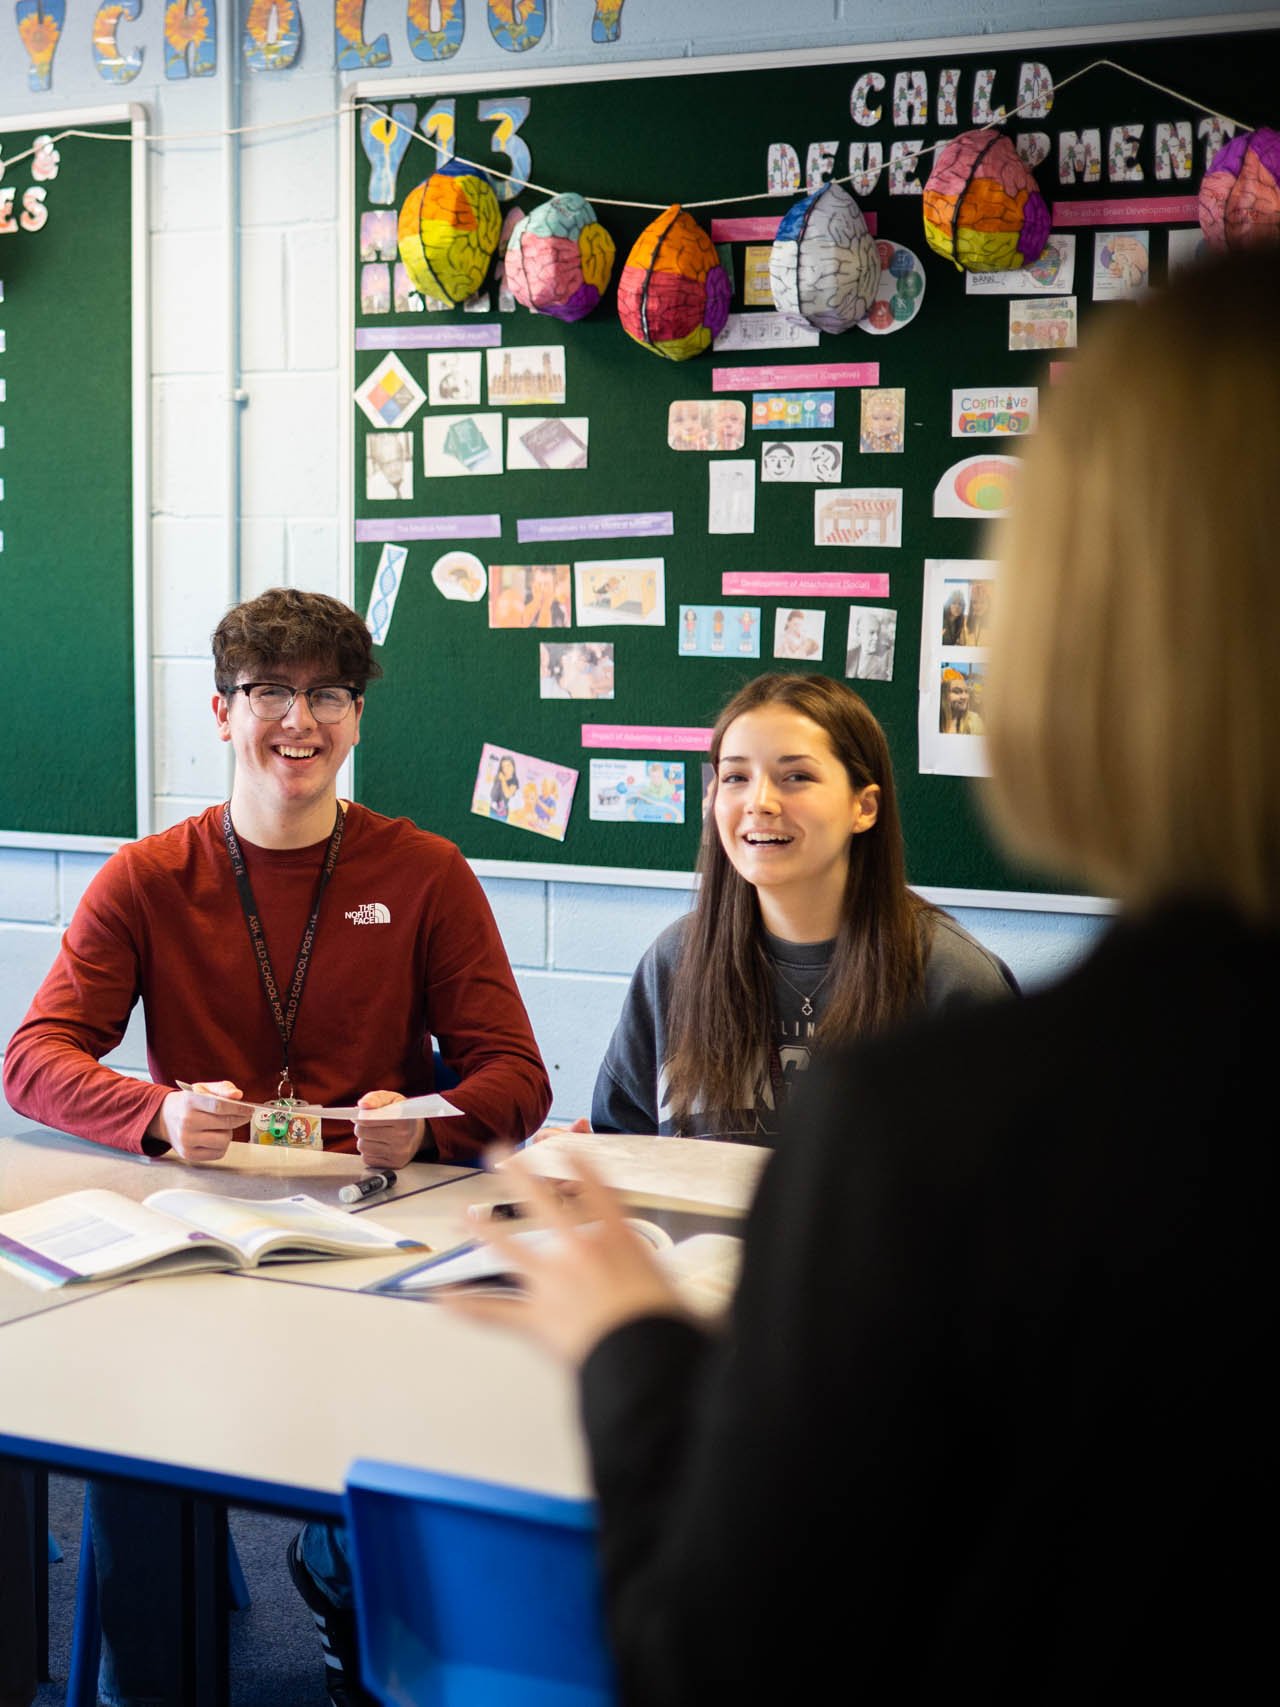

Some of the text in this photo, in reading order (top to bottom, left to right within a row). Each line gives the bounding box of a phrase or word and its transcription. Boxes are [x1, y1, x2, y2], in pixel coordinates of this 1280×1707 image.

[850, 61, 1054, 126] CHILD
[31, 135, 60, 181] &
[359, 97, 532, 204] Y13
[767, 116, 1237, 196] DEVEPMENT
[740, 578, 788, 590] Development
[228, 836, 242, 863] POST
[345, 911, 375, 919] NORTH
[353, 917, 375, 925] FACE
[358, 904, 375, 912] THE
[299, 928, 315, 957] POST
[260, 958, 278, 1001] SCHOOL
[271, 1000, 285, 1027] POST
[291, 955, 308, 999] SCHOOL
